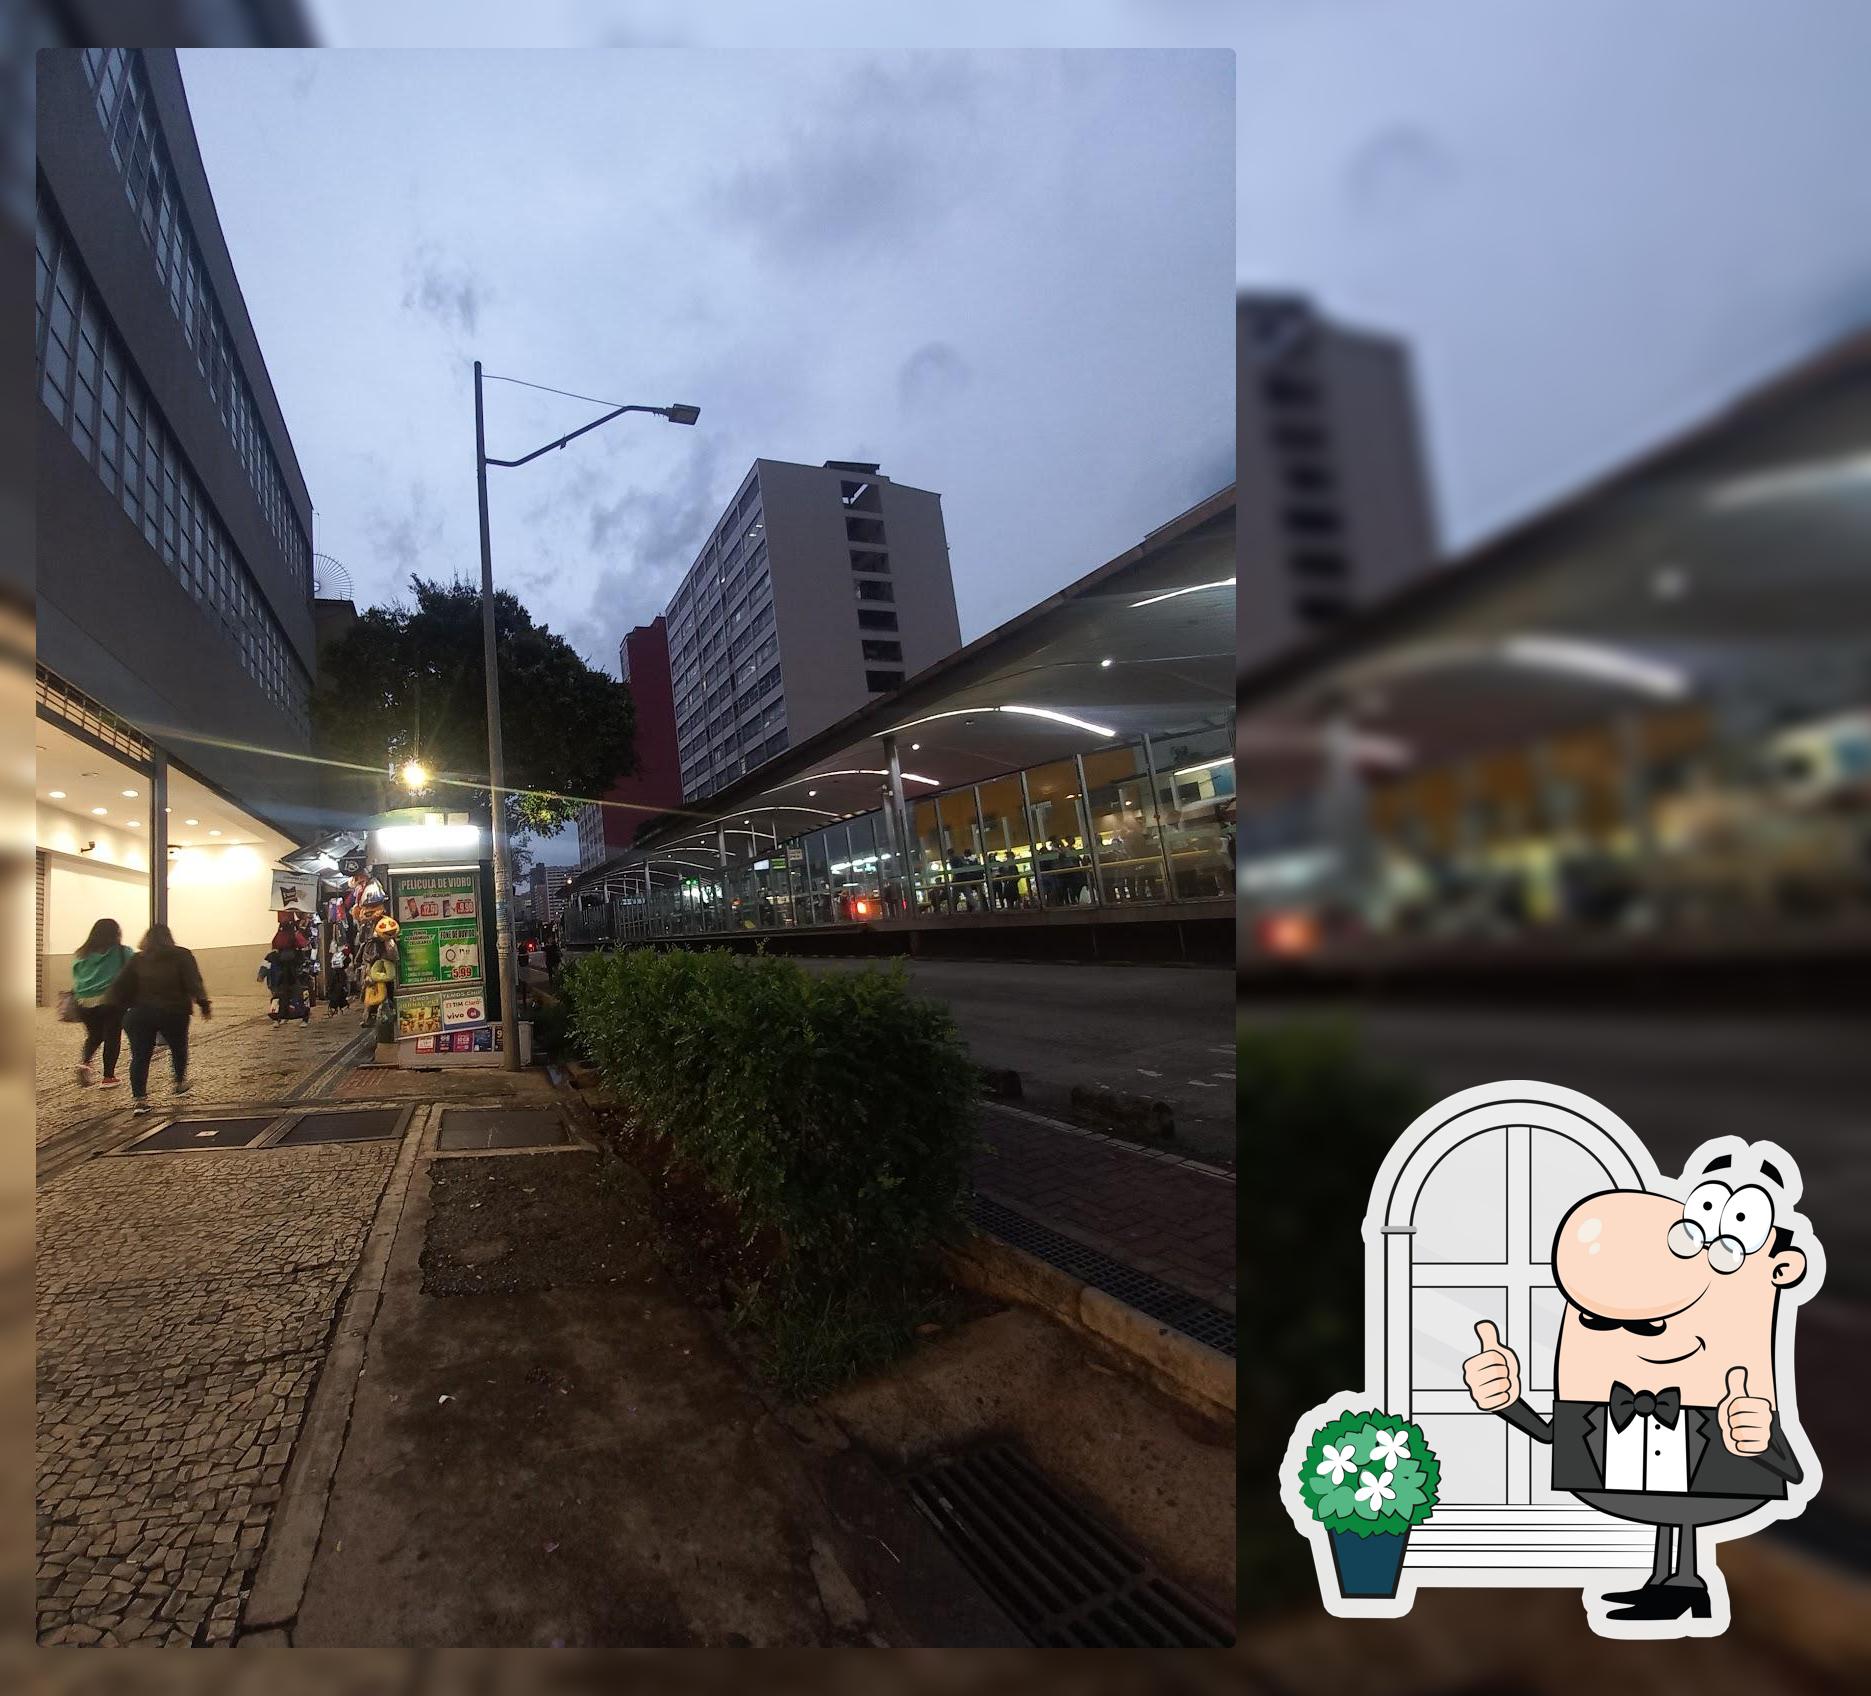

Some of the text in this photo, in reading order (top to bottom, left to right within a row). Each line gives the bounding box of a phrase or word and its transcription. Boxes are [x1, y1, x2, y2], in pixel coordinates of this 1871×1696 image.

[401, 876, 471, 890] PELÍCULA DE VIDRO
[447, 1012, 465, 1020] vivo
